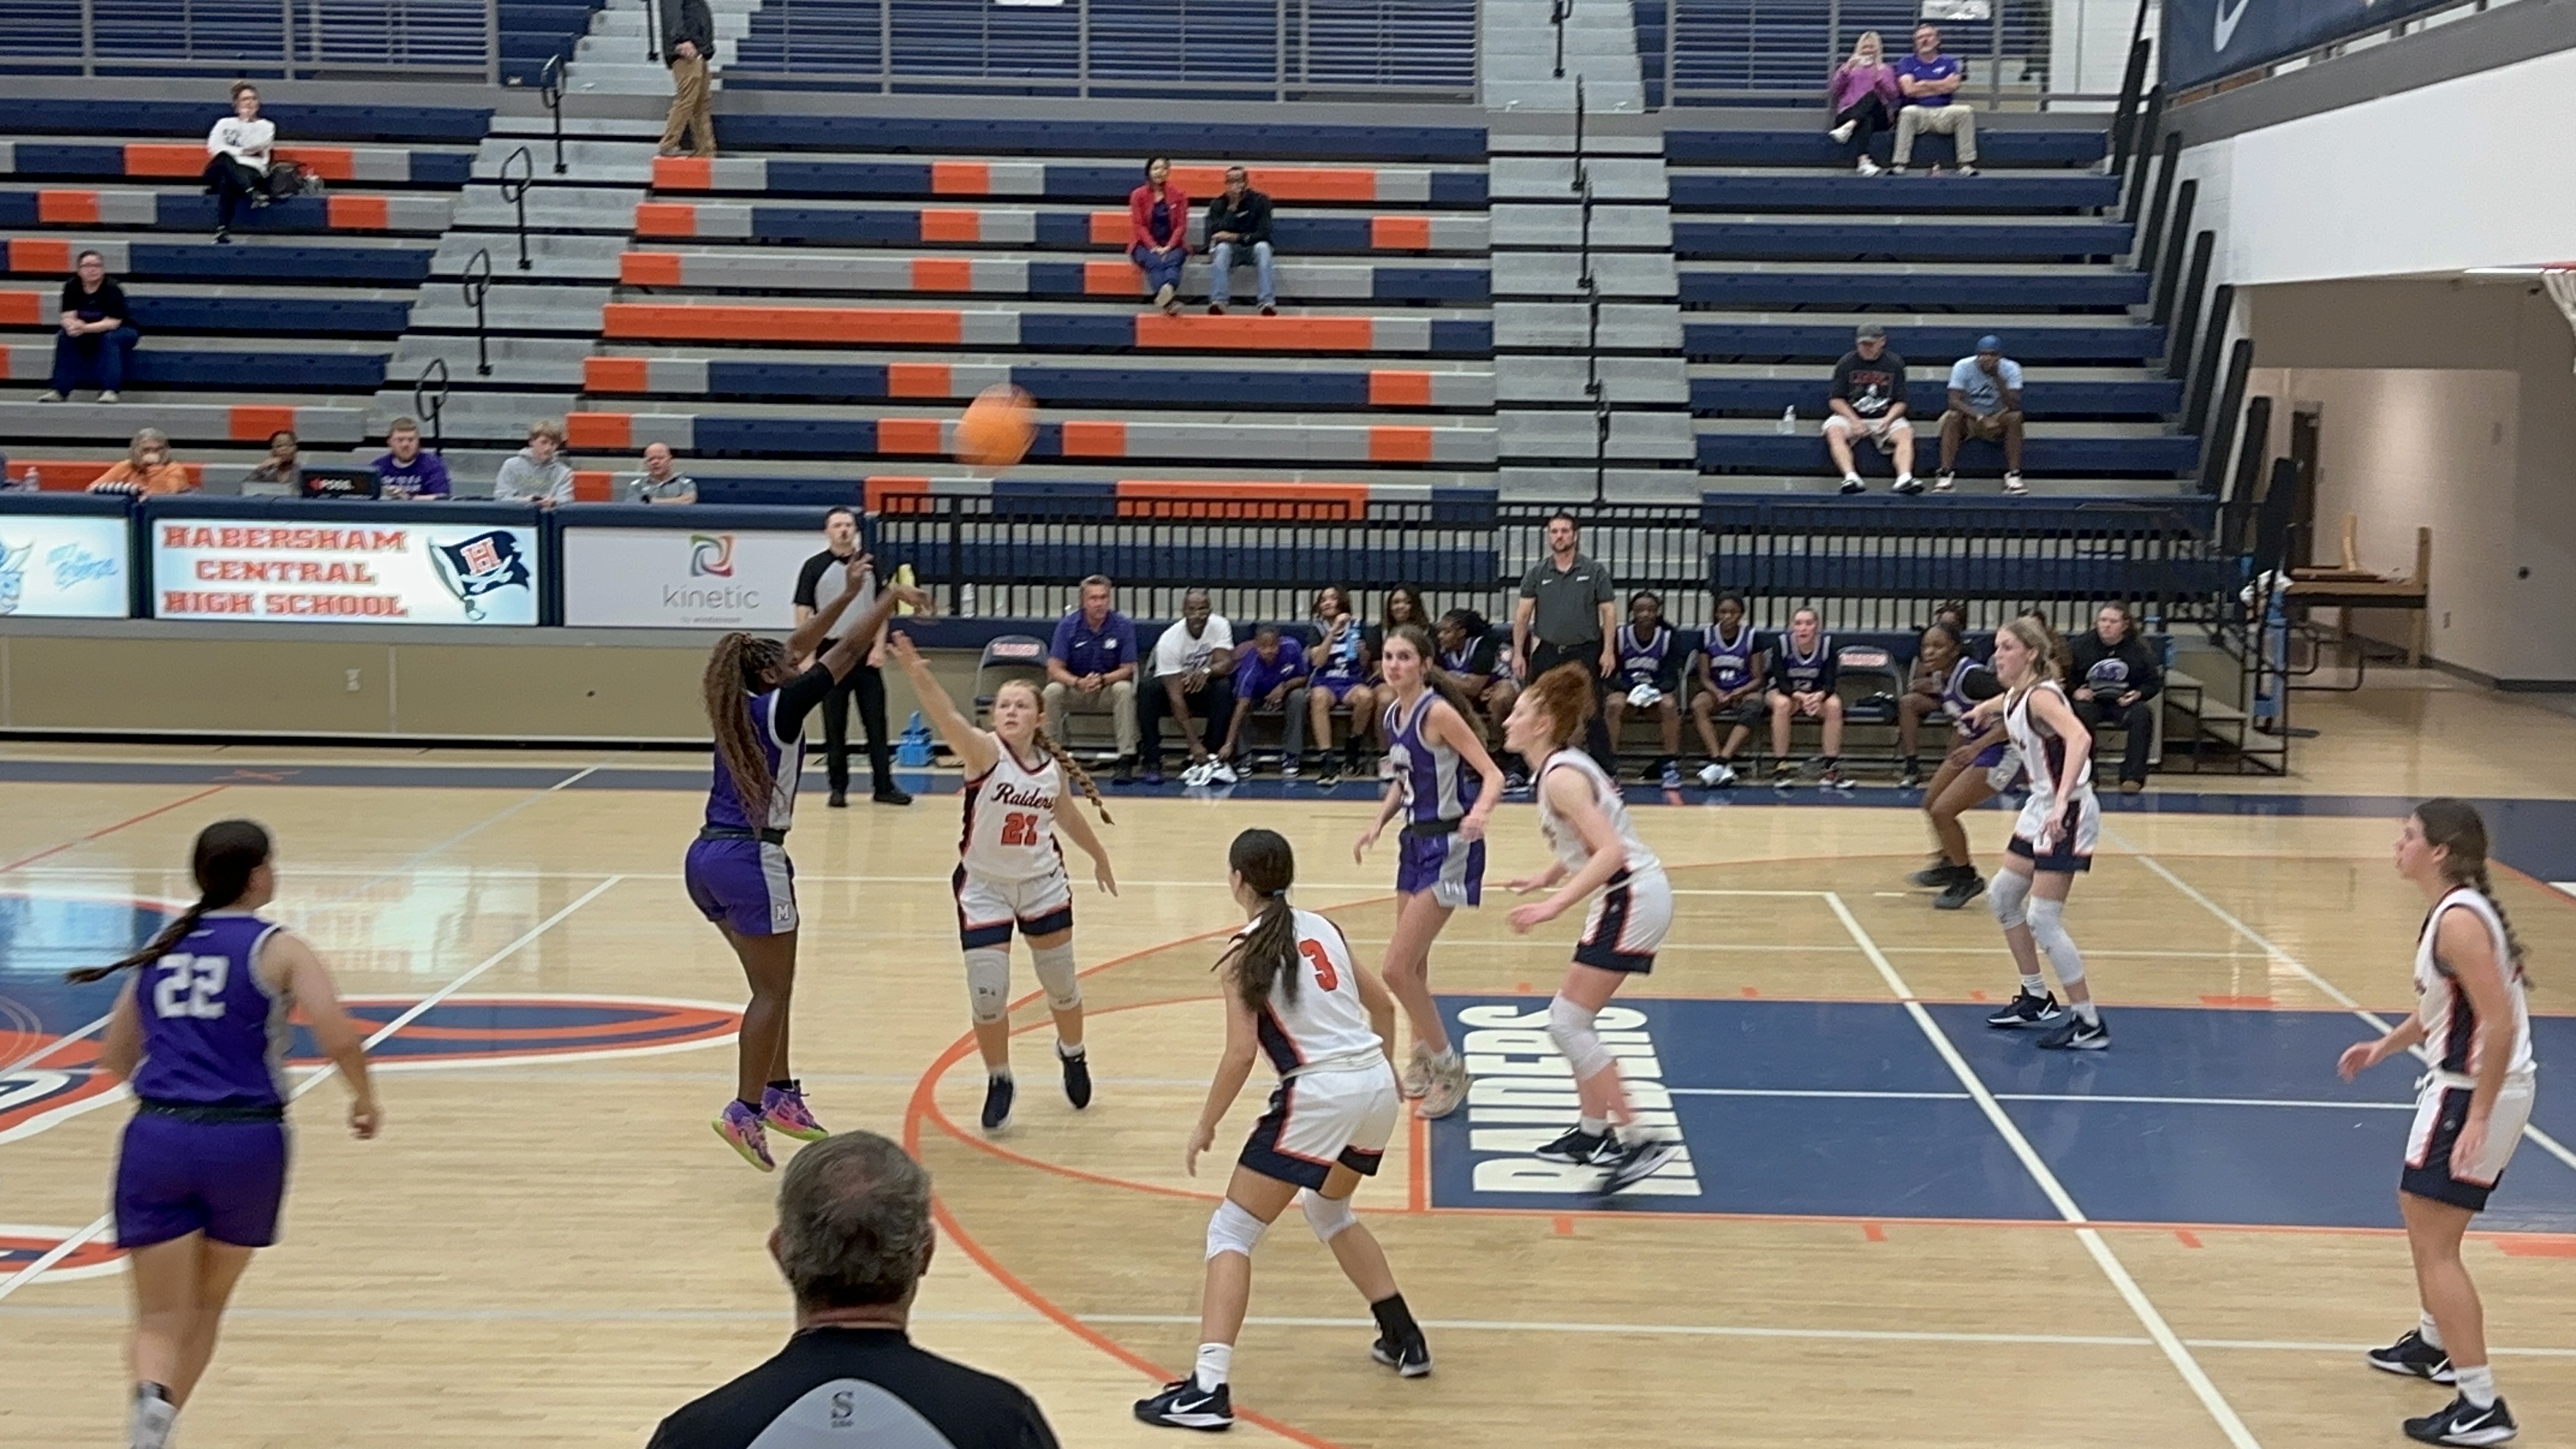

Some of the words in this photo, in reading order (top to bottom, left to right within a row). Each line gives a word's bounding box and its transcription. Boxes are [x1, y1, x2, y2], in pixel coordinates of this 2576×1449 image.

[162, 525, 408, 553] HABERSHAM
[195, 560, 379, 585] CENTRAL
[163, 591, 255, 615] HIGH
[265, 593, 409, 618] SCHOOL
[662, 583, 760, 610] kinetic
[1000, 812, 1038, 846] 21
[776, 904, 790, 921] M
[1298, 937, 1338, 993] 3
[153, 952, 231, 1020] 22
[831, 1390, 854, 1418] S
